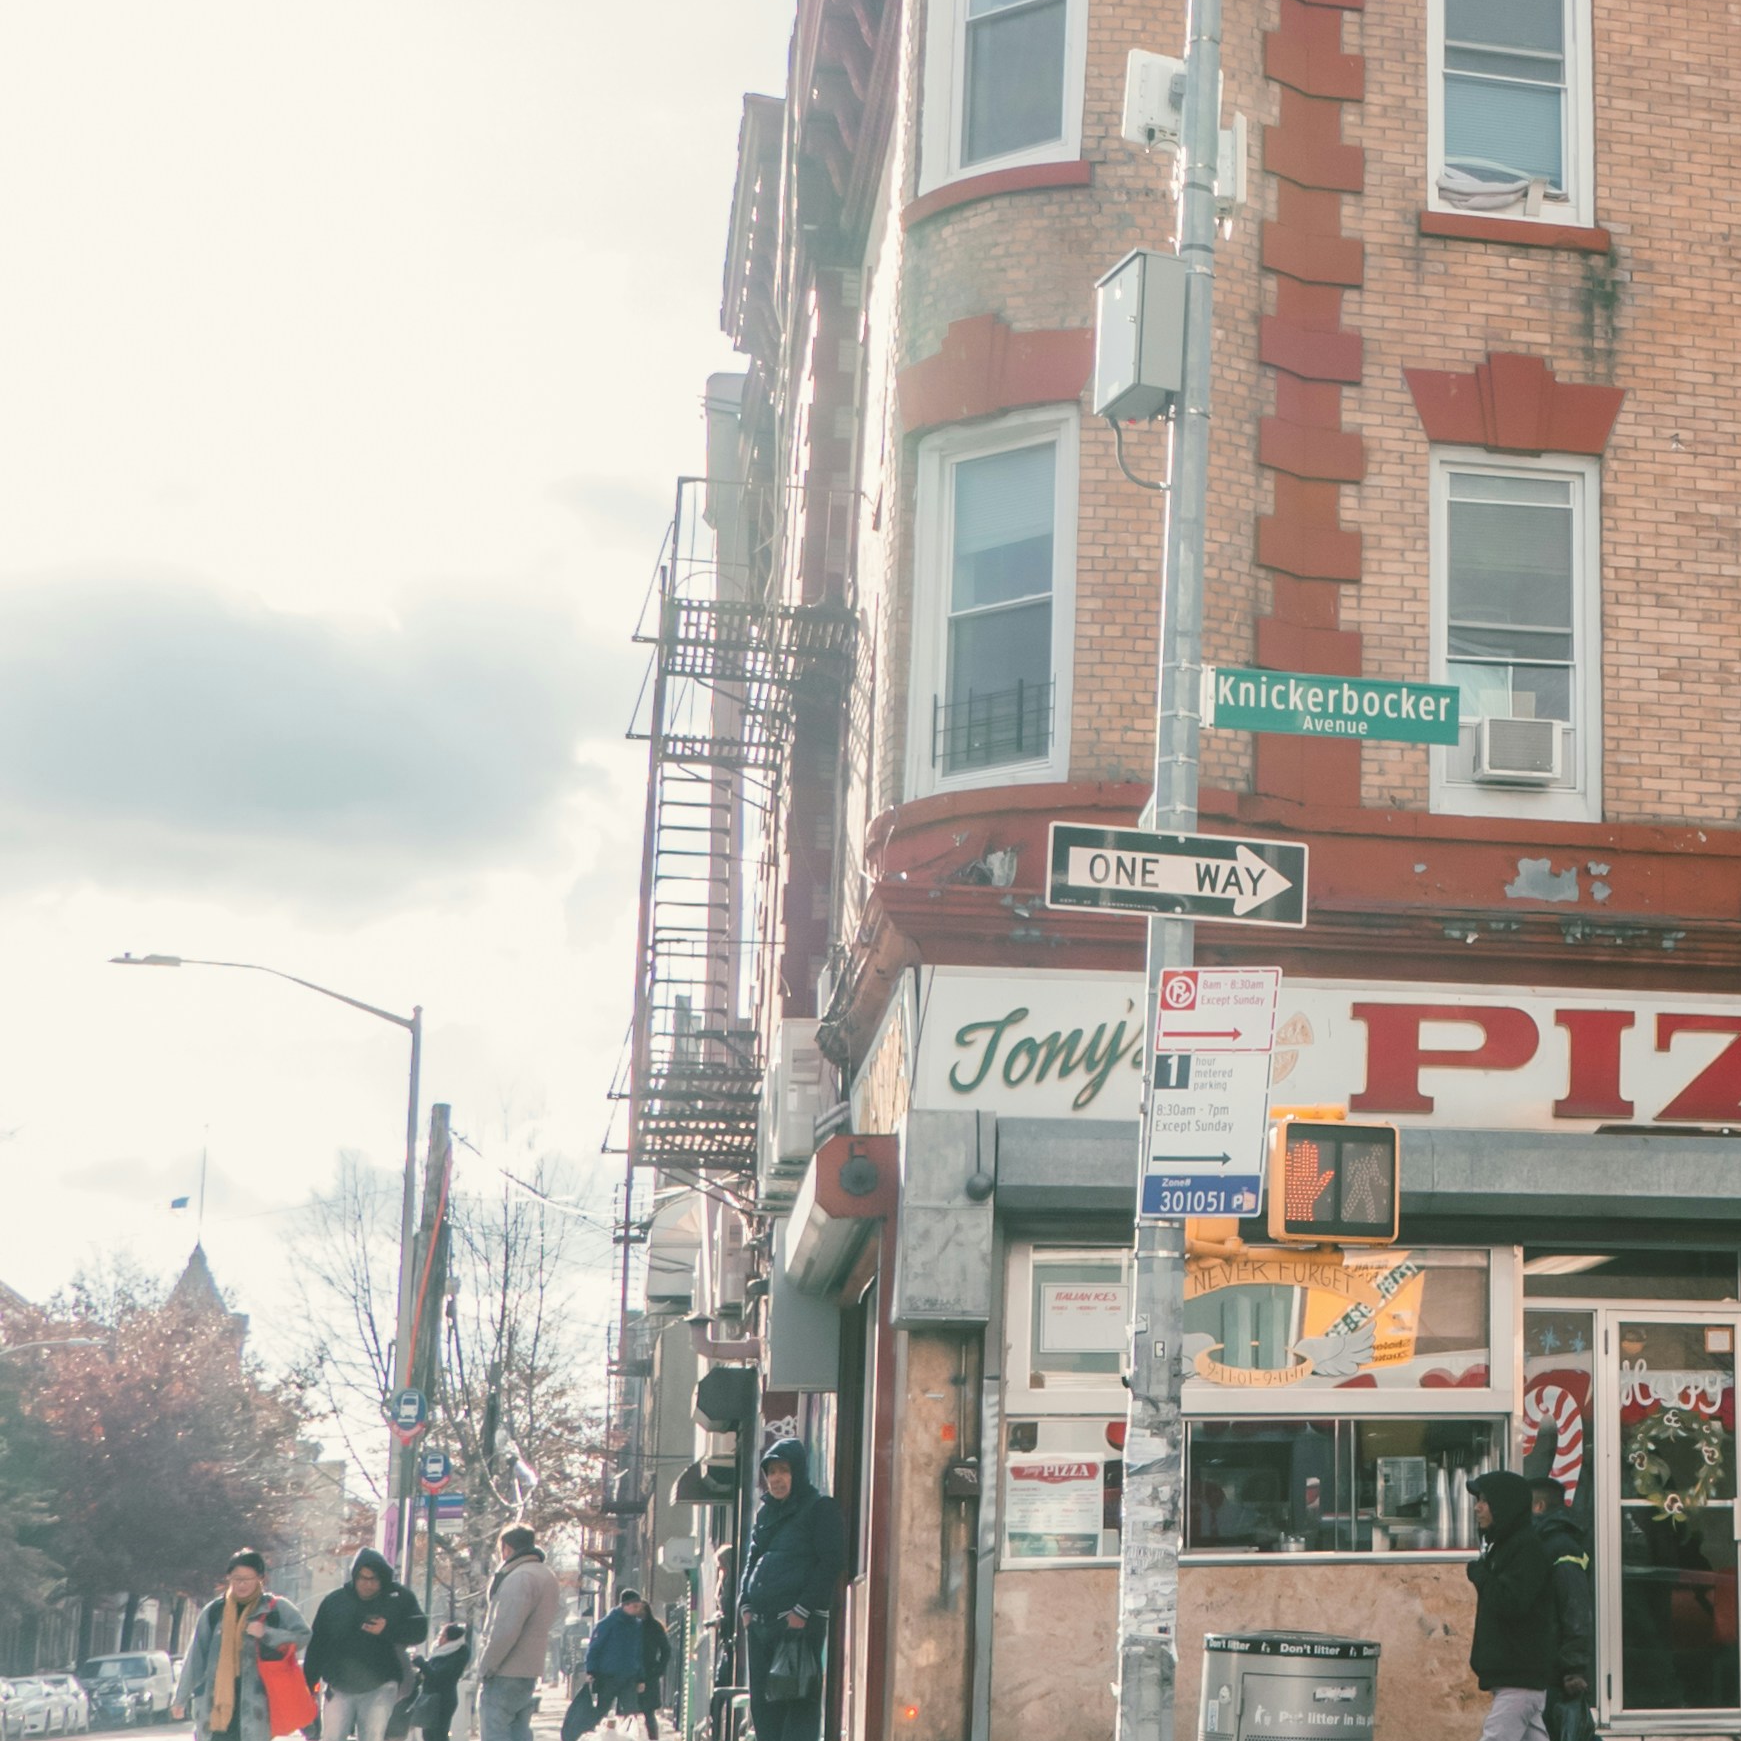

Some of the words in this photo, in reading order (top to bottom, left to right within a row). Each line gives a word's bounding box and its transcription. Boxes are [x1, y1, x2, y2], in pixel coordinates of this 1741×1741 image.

[1218, 675, 1450, 721] Knickerbocker
[1303, 715, 1368, 735] Avenue
[1089, 853, 1160, 888] ONE
[1195, 862, 1266, 897] WAY
[1202, 979, 1222, 990] 8am
[1230, 979, 1265, 990] 8:30am
[1200, 995, 1230, 1006] Except
[1233, 995, 1265, 1007] Sunday
[1167, 1055, 1179, 1087] 1
[1195, 1057, 1216, 1066] hour
[1194, 1068, 1233, 1078] metered
[1193, 1079, 1227, 1091] parking
[1156, 1103, 1196, 1116] 8:30am
[1208, 1104, 1230, 1117] 7pm
[1155, 1120, 1192, 1133] Except
[1195, 1120, 1234, 1133] Sunday
[1160, 1190, 1226, 1212] 301051
[1193, 1261, 1269, 1295] NEVER
[1619, 1358, 1725, 1414] Happy
[1042, 1463, 1090, 1477] PIZZA
[1280, 1642, 1311, 1654] Don't
[1314, 1645, 1341, 1656] litter
[1308, 1712, 1340, 1725] litter
[1343, 1712, 1354, 1726] in
